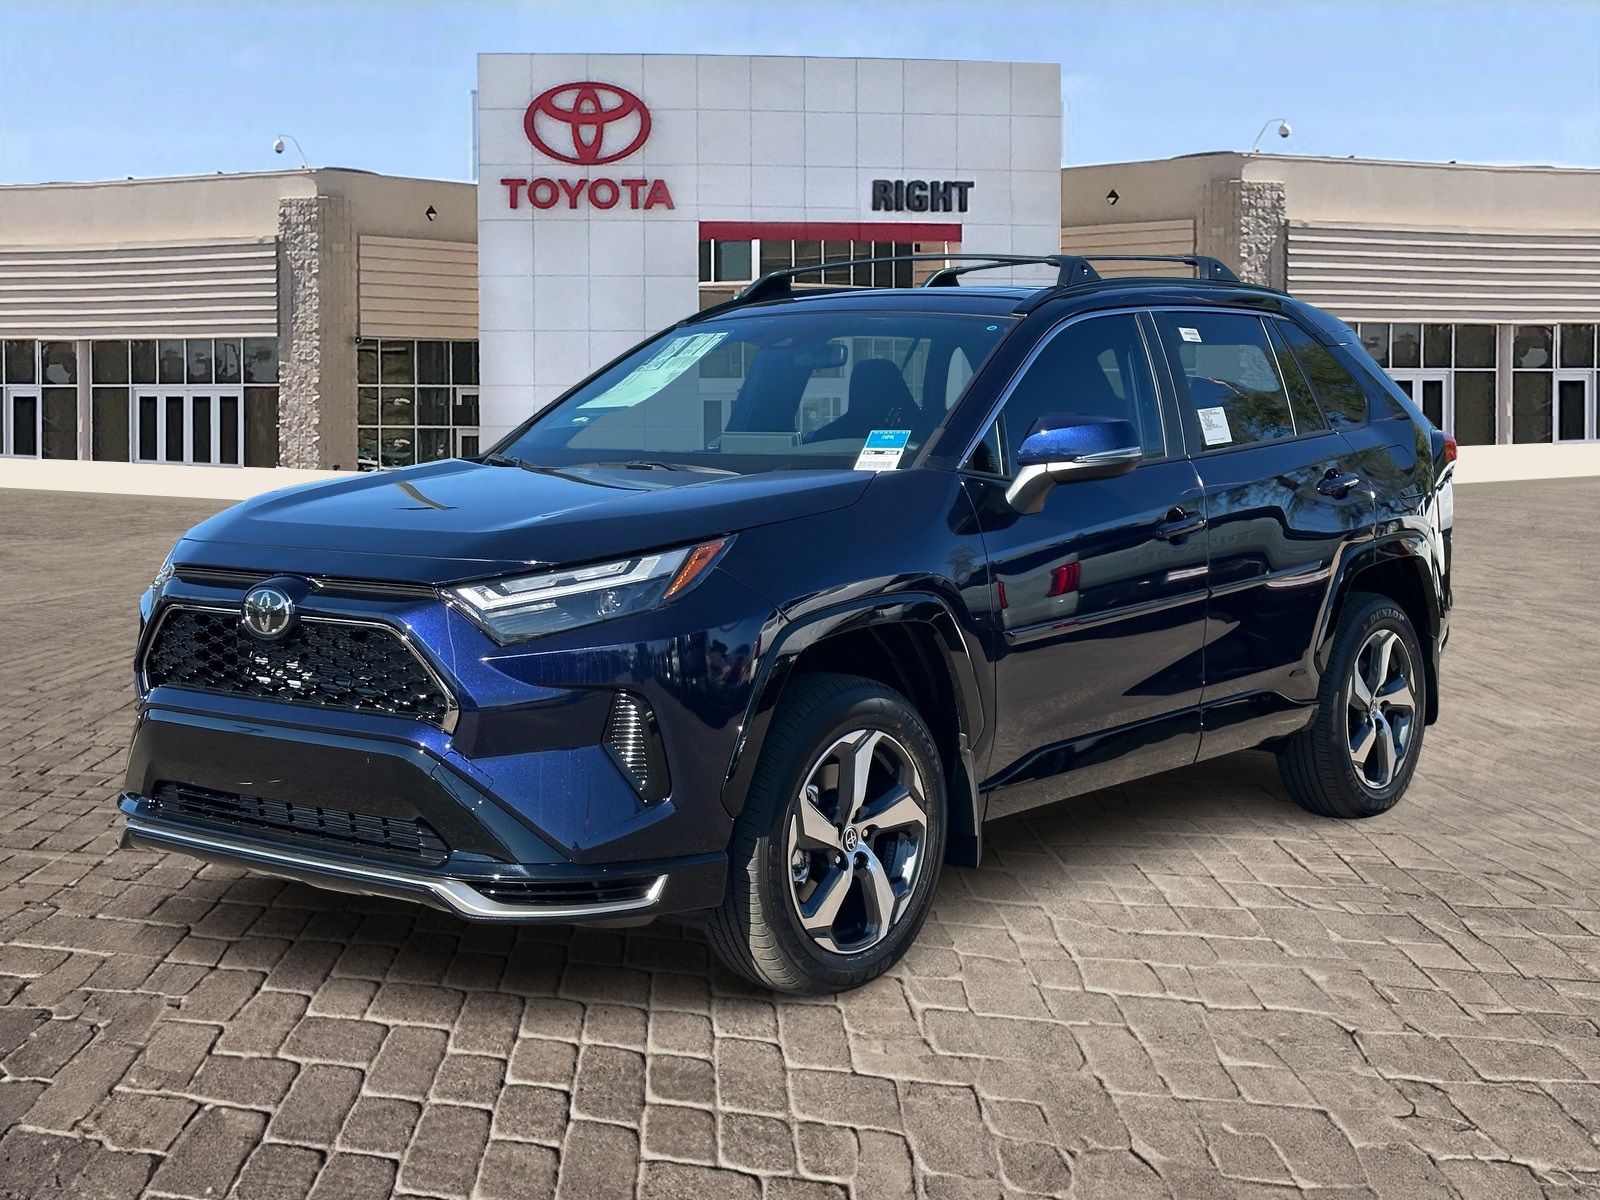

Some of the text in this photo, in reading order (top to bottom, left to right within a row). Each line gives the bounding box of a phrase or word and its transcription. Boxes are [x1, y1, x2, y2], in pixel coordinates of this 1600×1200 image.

[500, 178, 674, 211] TOYOTA
[871, 179, 976, 213] RIGHT
[1369, 607, 1405, 626] DUNLOP
